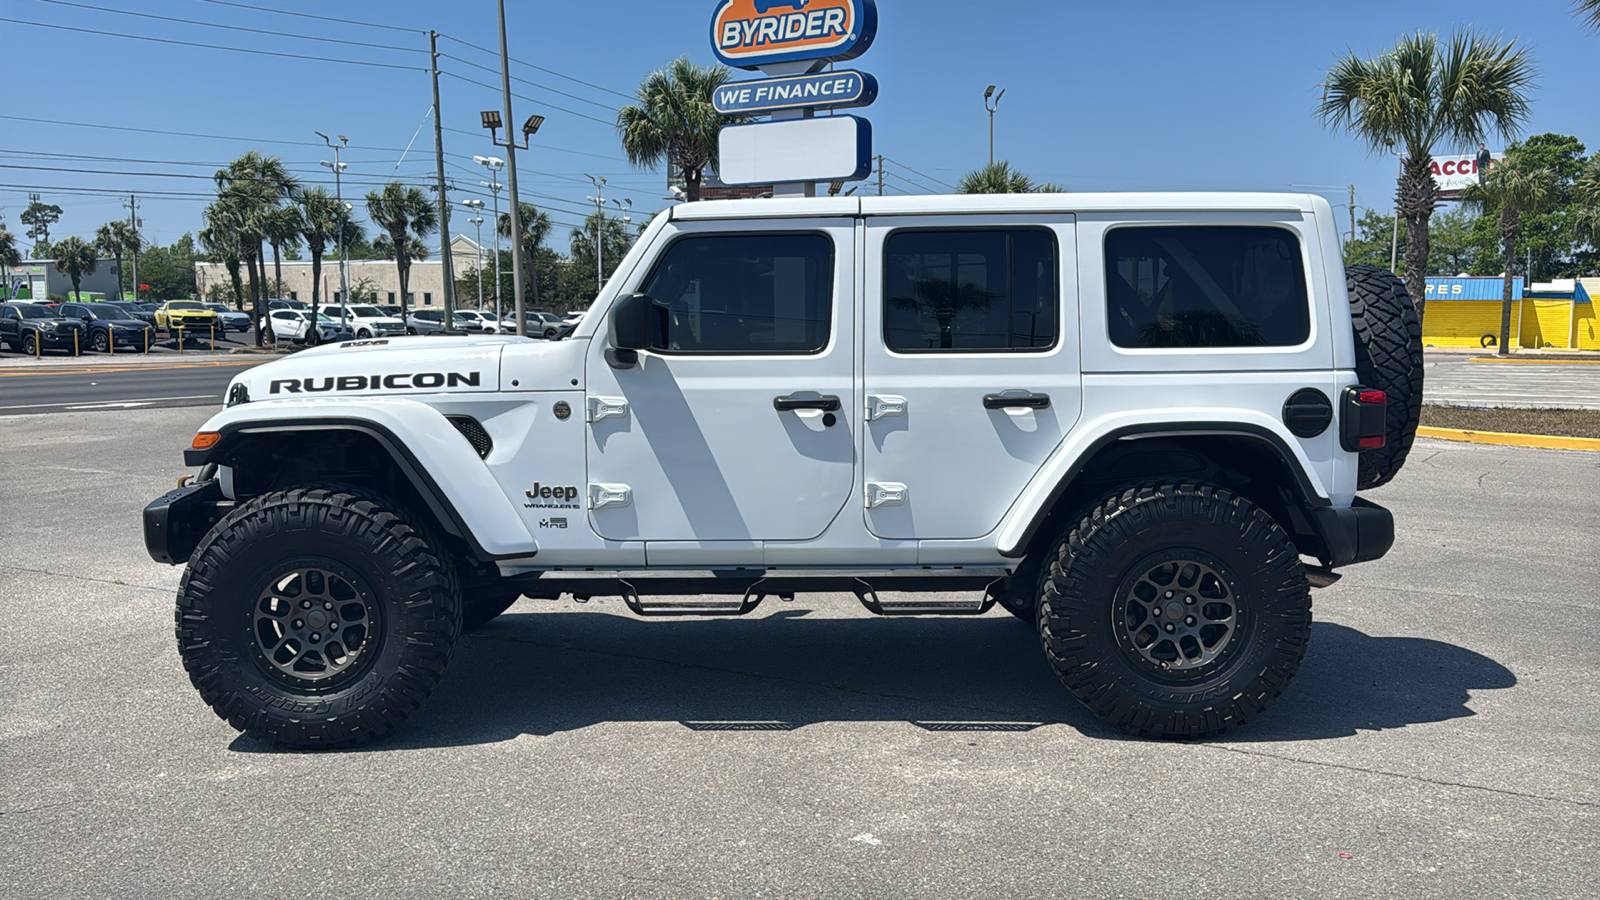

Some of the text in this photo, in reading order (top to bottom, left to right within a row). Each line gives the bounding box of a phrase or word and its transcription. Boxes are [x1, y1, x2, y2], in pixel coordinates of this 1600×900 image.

[721, 8, 846, 48] BYRIDER
[720, 78, 854, 105] WE FINANCE!
[1424, 284, 1463, 295] RES
[269, 371, 481, 395] RUBICON
[525, 481, 578, 502] Jeep
